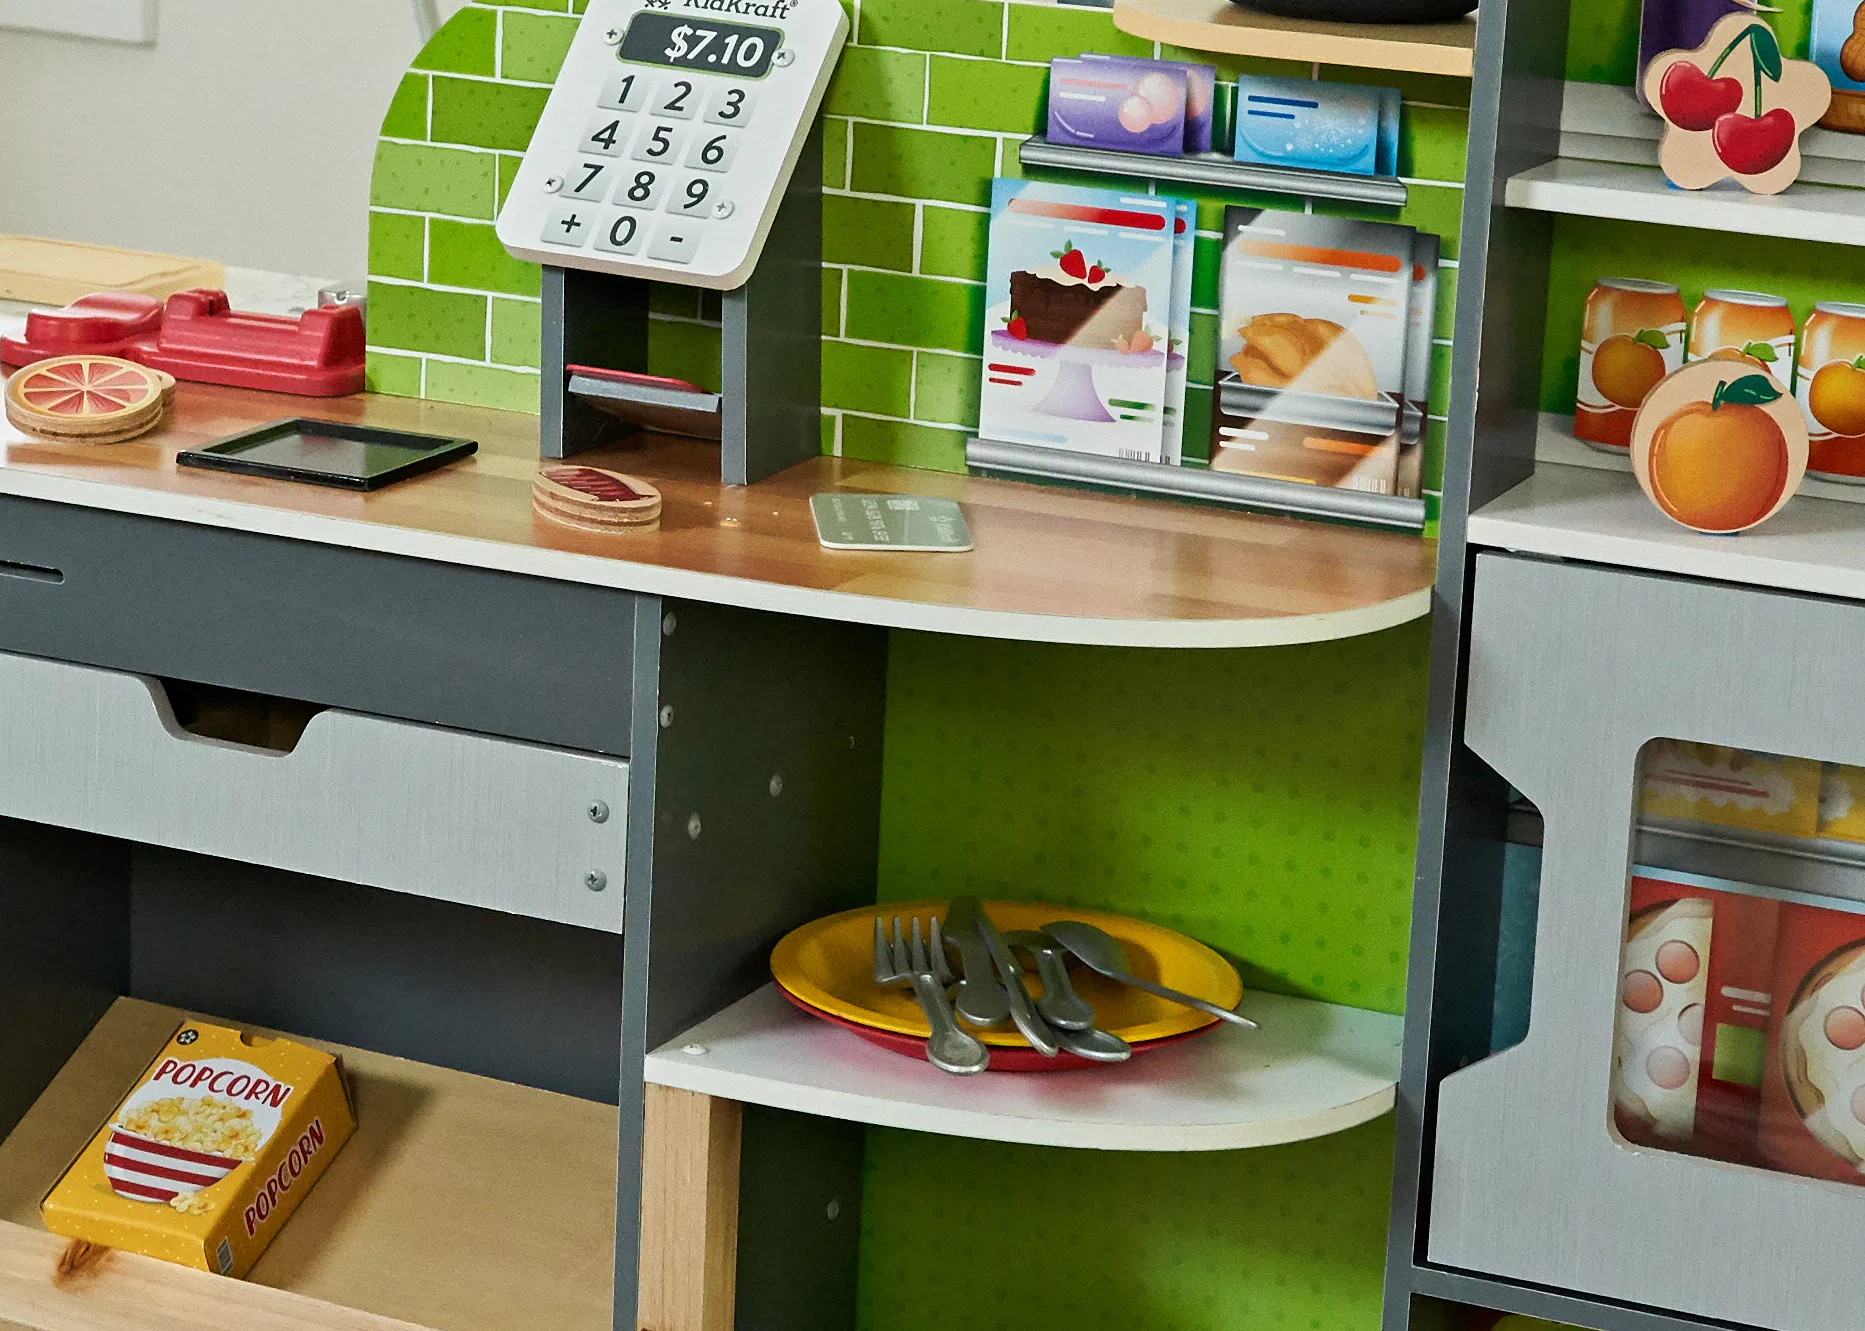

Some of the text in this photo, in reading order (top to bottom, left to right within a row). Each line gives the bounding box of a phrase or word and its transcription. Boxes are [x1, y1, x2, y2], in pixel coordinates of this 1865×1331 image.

[663, 24, 765, 68] $7.10
[618, 74, 746, 119] 1 2 3
[591, 120, 727, 165] 4 5 6
[573, 163, 710, 210] 7 8 9
[609, 215, 637, 247] 0
[152, 1059, 291, 1109] POPCORN
[244, 1118, 326, 1237] POPCORN
